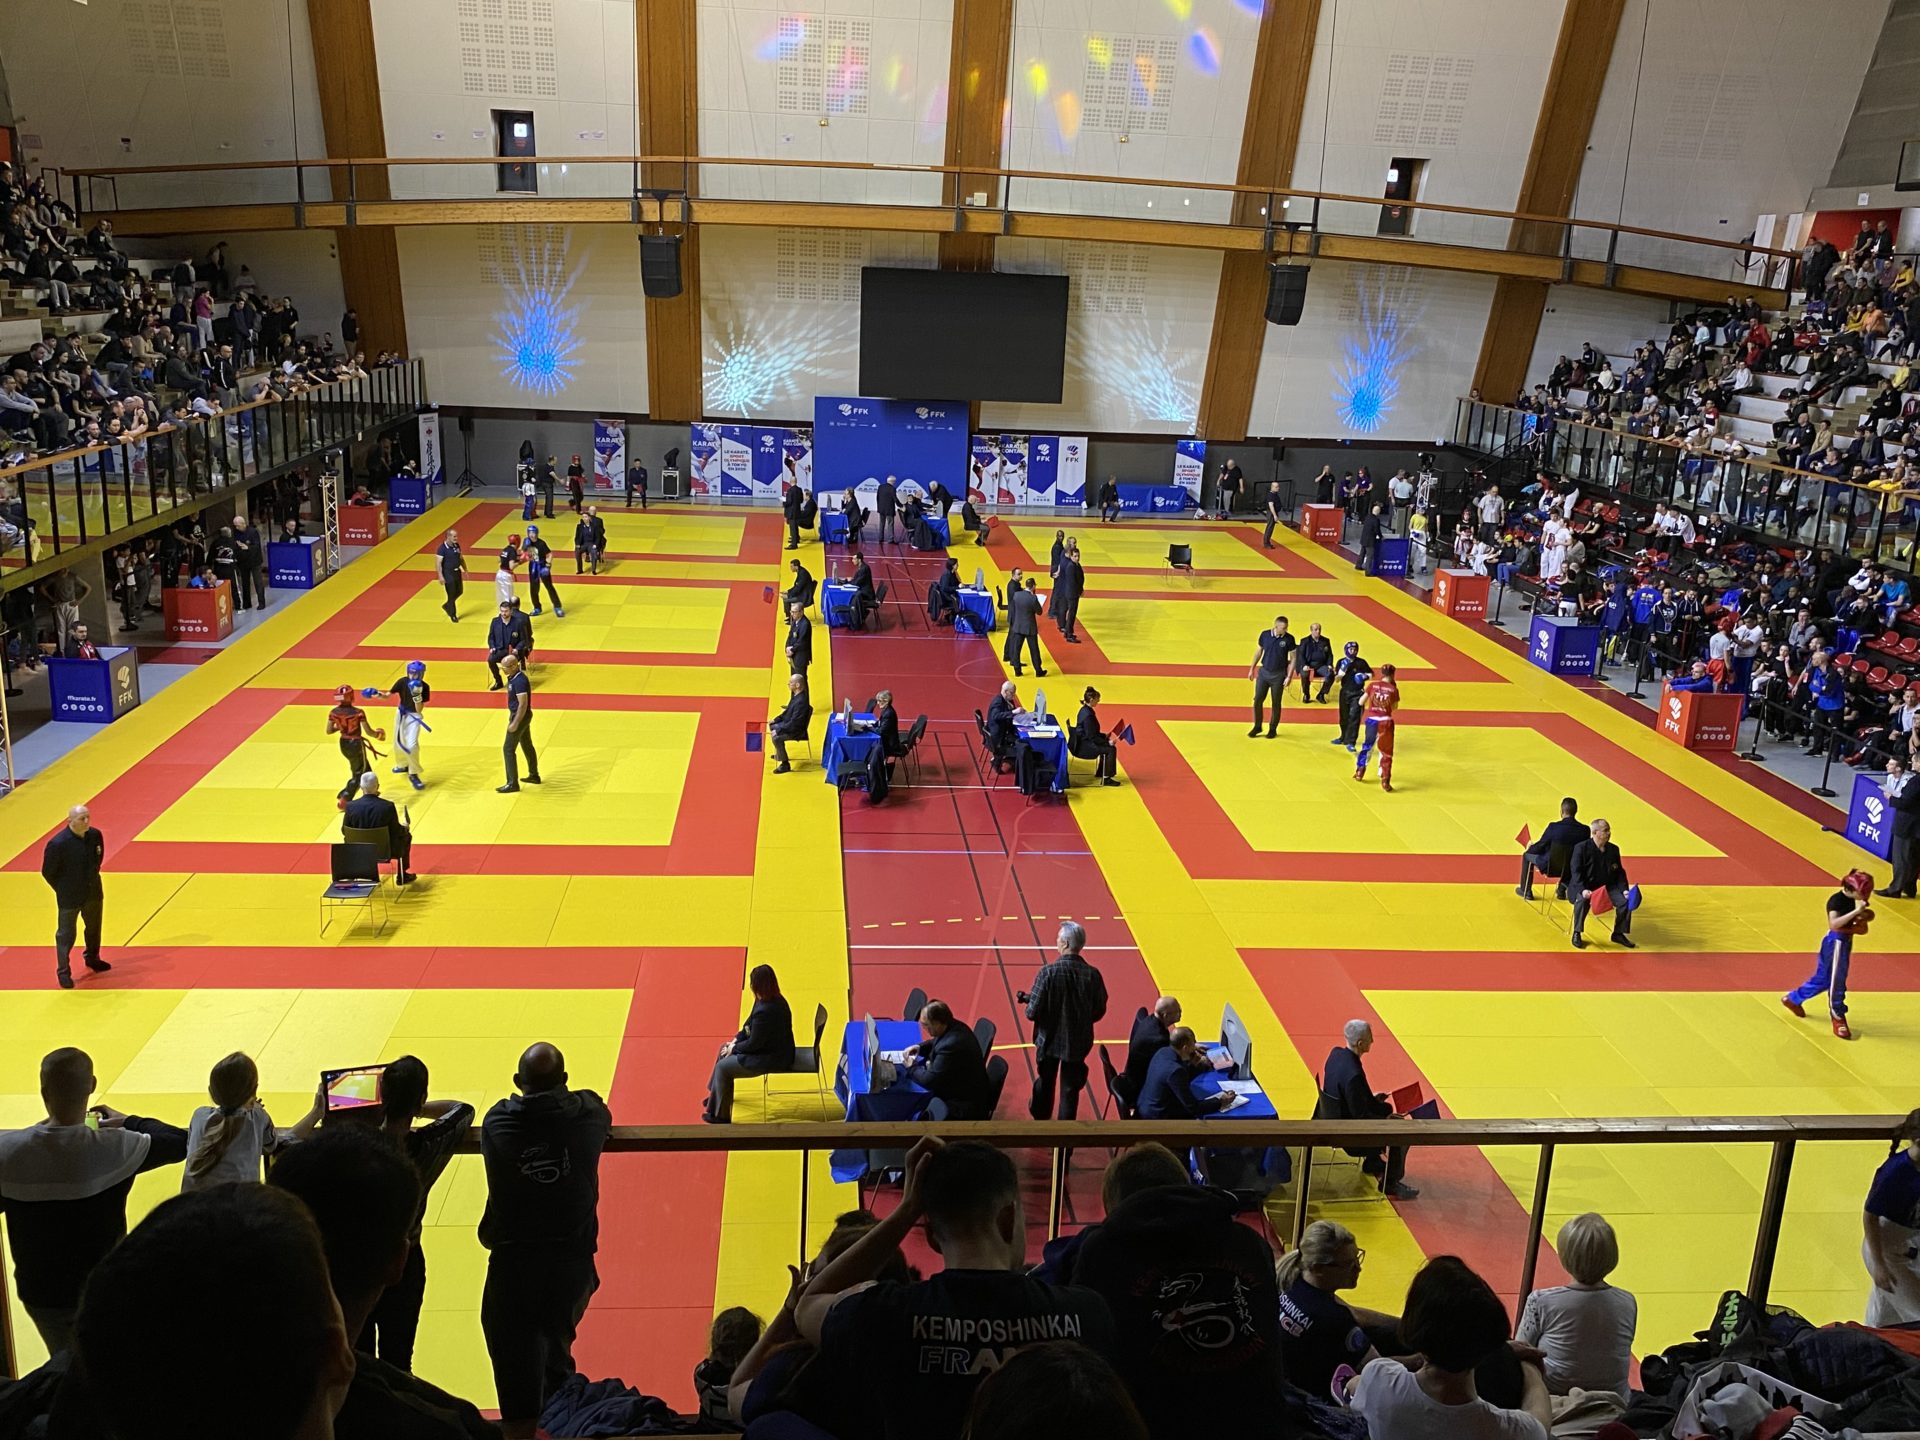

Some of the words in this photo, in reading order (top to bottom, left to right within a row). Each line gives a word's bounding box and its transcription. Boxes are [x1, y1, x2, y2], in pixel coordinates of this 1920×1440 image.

[853, 407, 869, 415] FFK
[315, 567, 324, 579] FFK
[1435, 596, 1445, 608] FFK
[219, 614, 229, 629] FFK
[1535, 648, 1548, 663] FFK
[118, 689, 133, 706] FFK
[1664, 718, 1680, 736] FFK
[1857, 821, 1880, 843] FFK
[912, 1313, 1081, 1343] KEMPOSHINKAI
